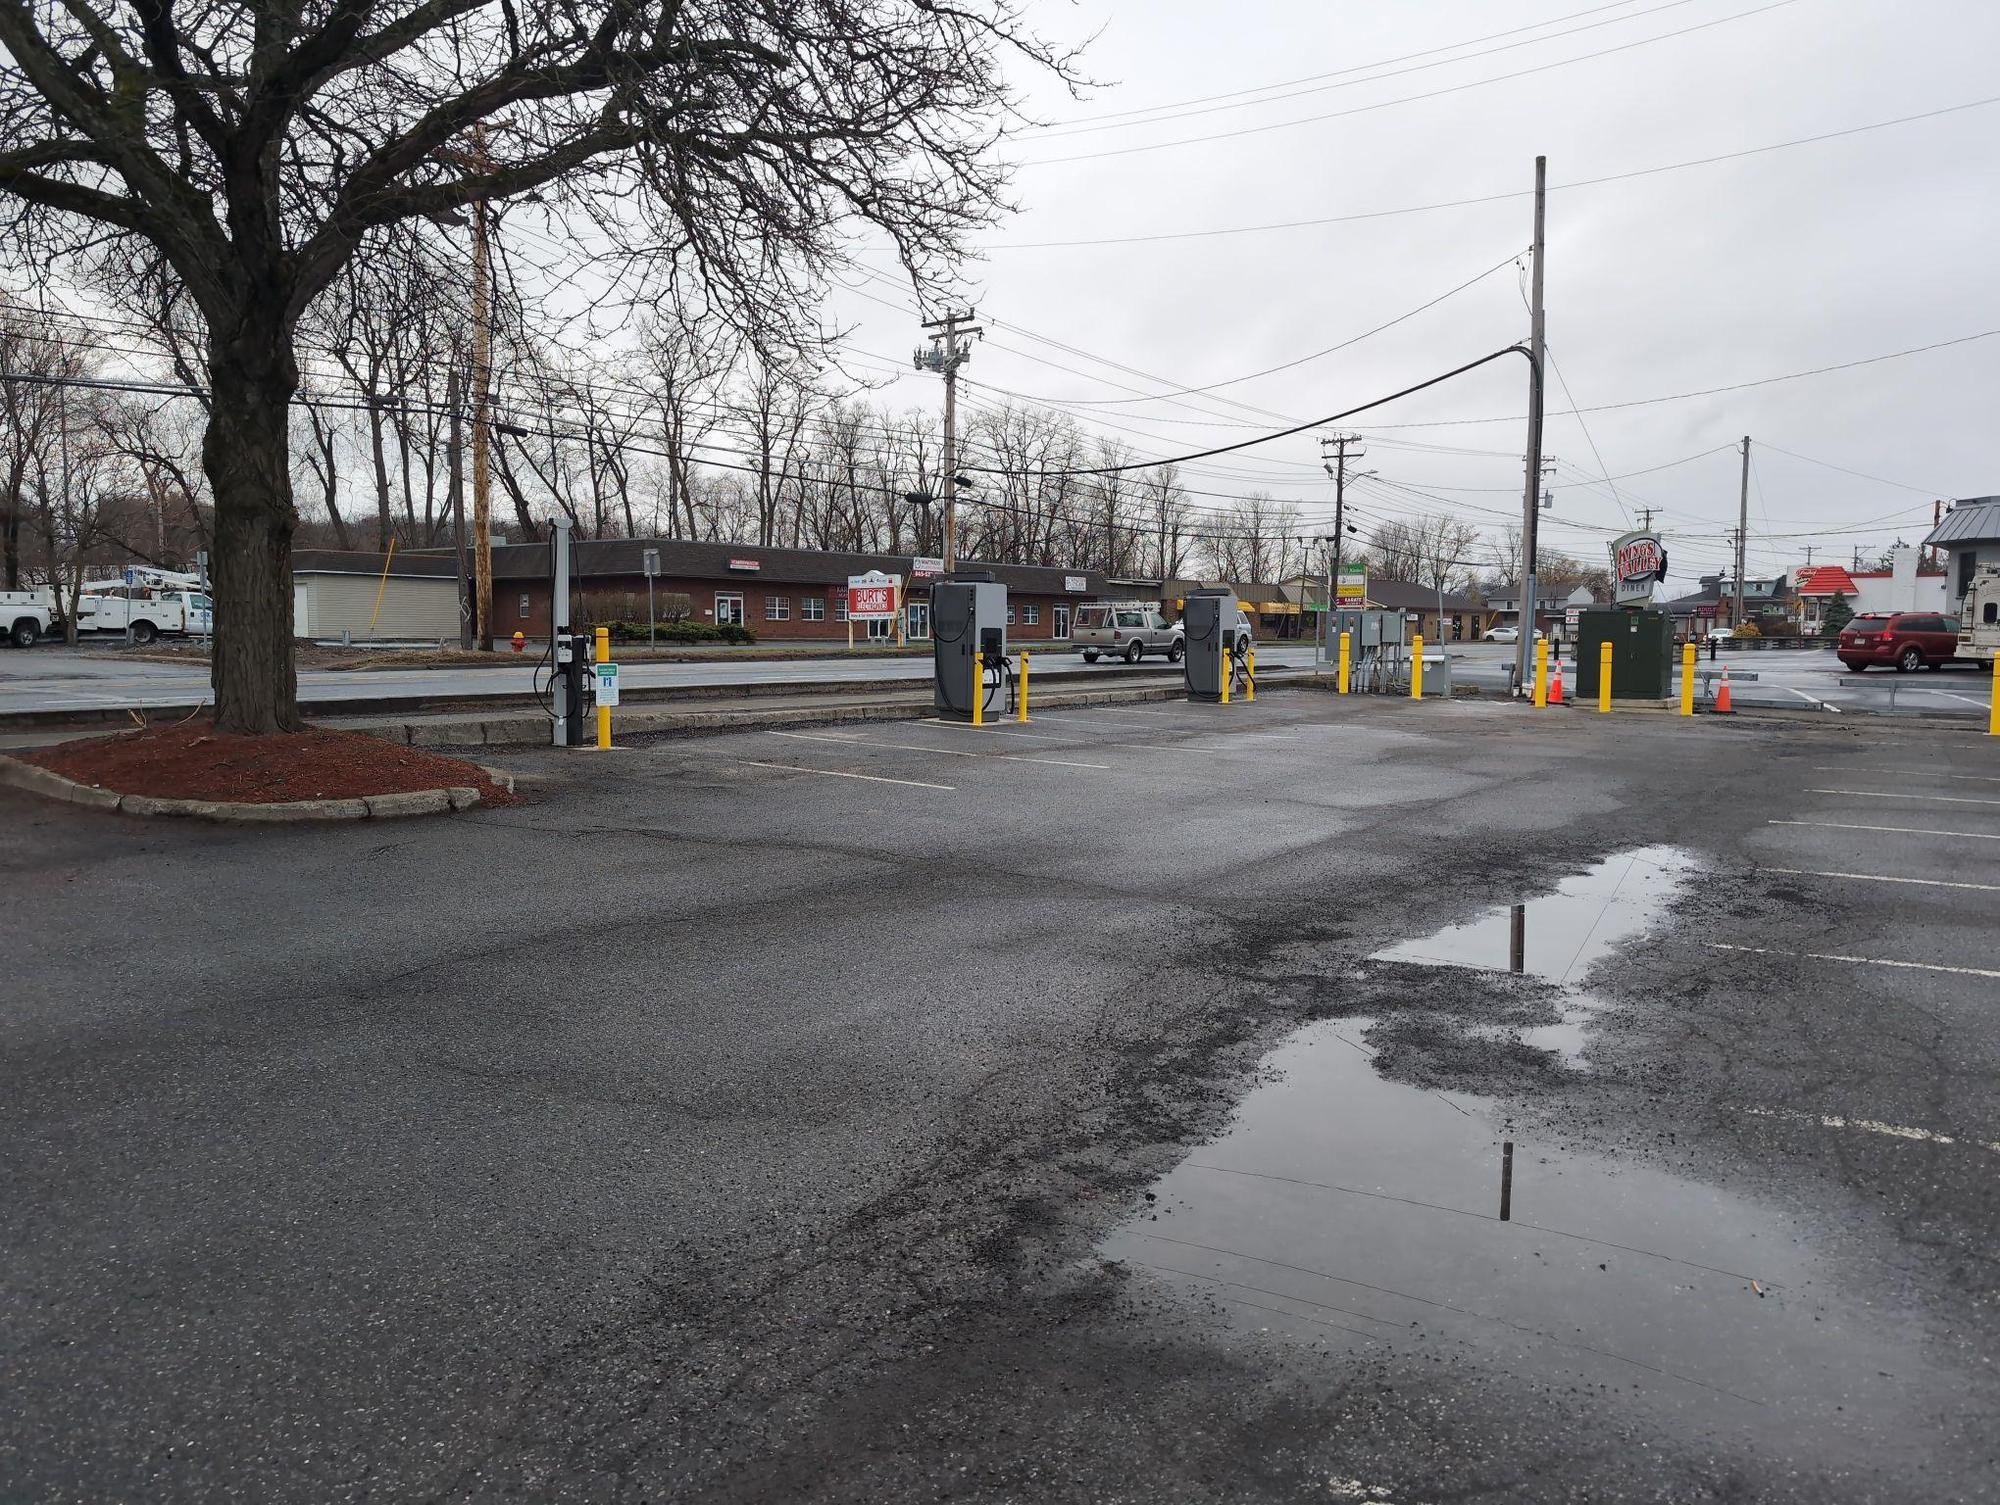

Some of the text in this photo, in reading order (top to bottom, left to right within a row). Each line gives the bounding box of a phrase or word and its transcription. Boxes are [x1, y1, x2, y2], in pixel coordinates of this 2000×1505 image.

[1617, 541, 1655, 565] KING'S
[1617, 555, 1663, 582] VALLEY
[1621, 583, 1645, 592] DINER
[856, 588, 888, 602] BURT'S
[856, 602, 888, 611] ELECTRONICS
